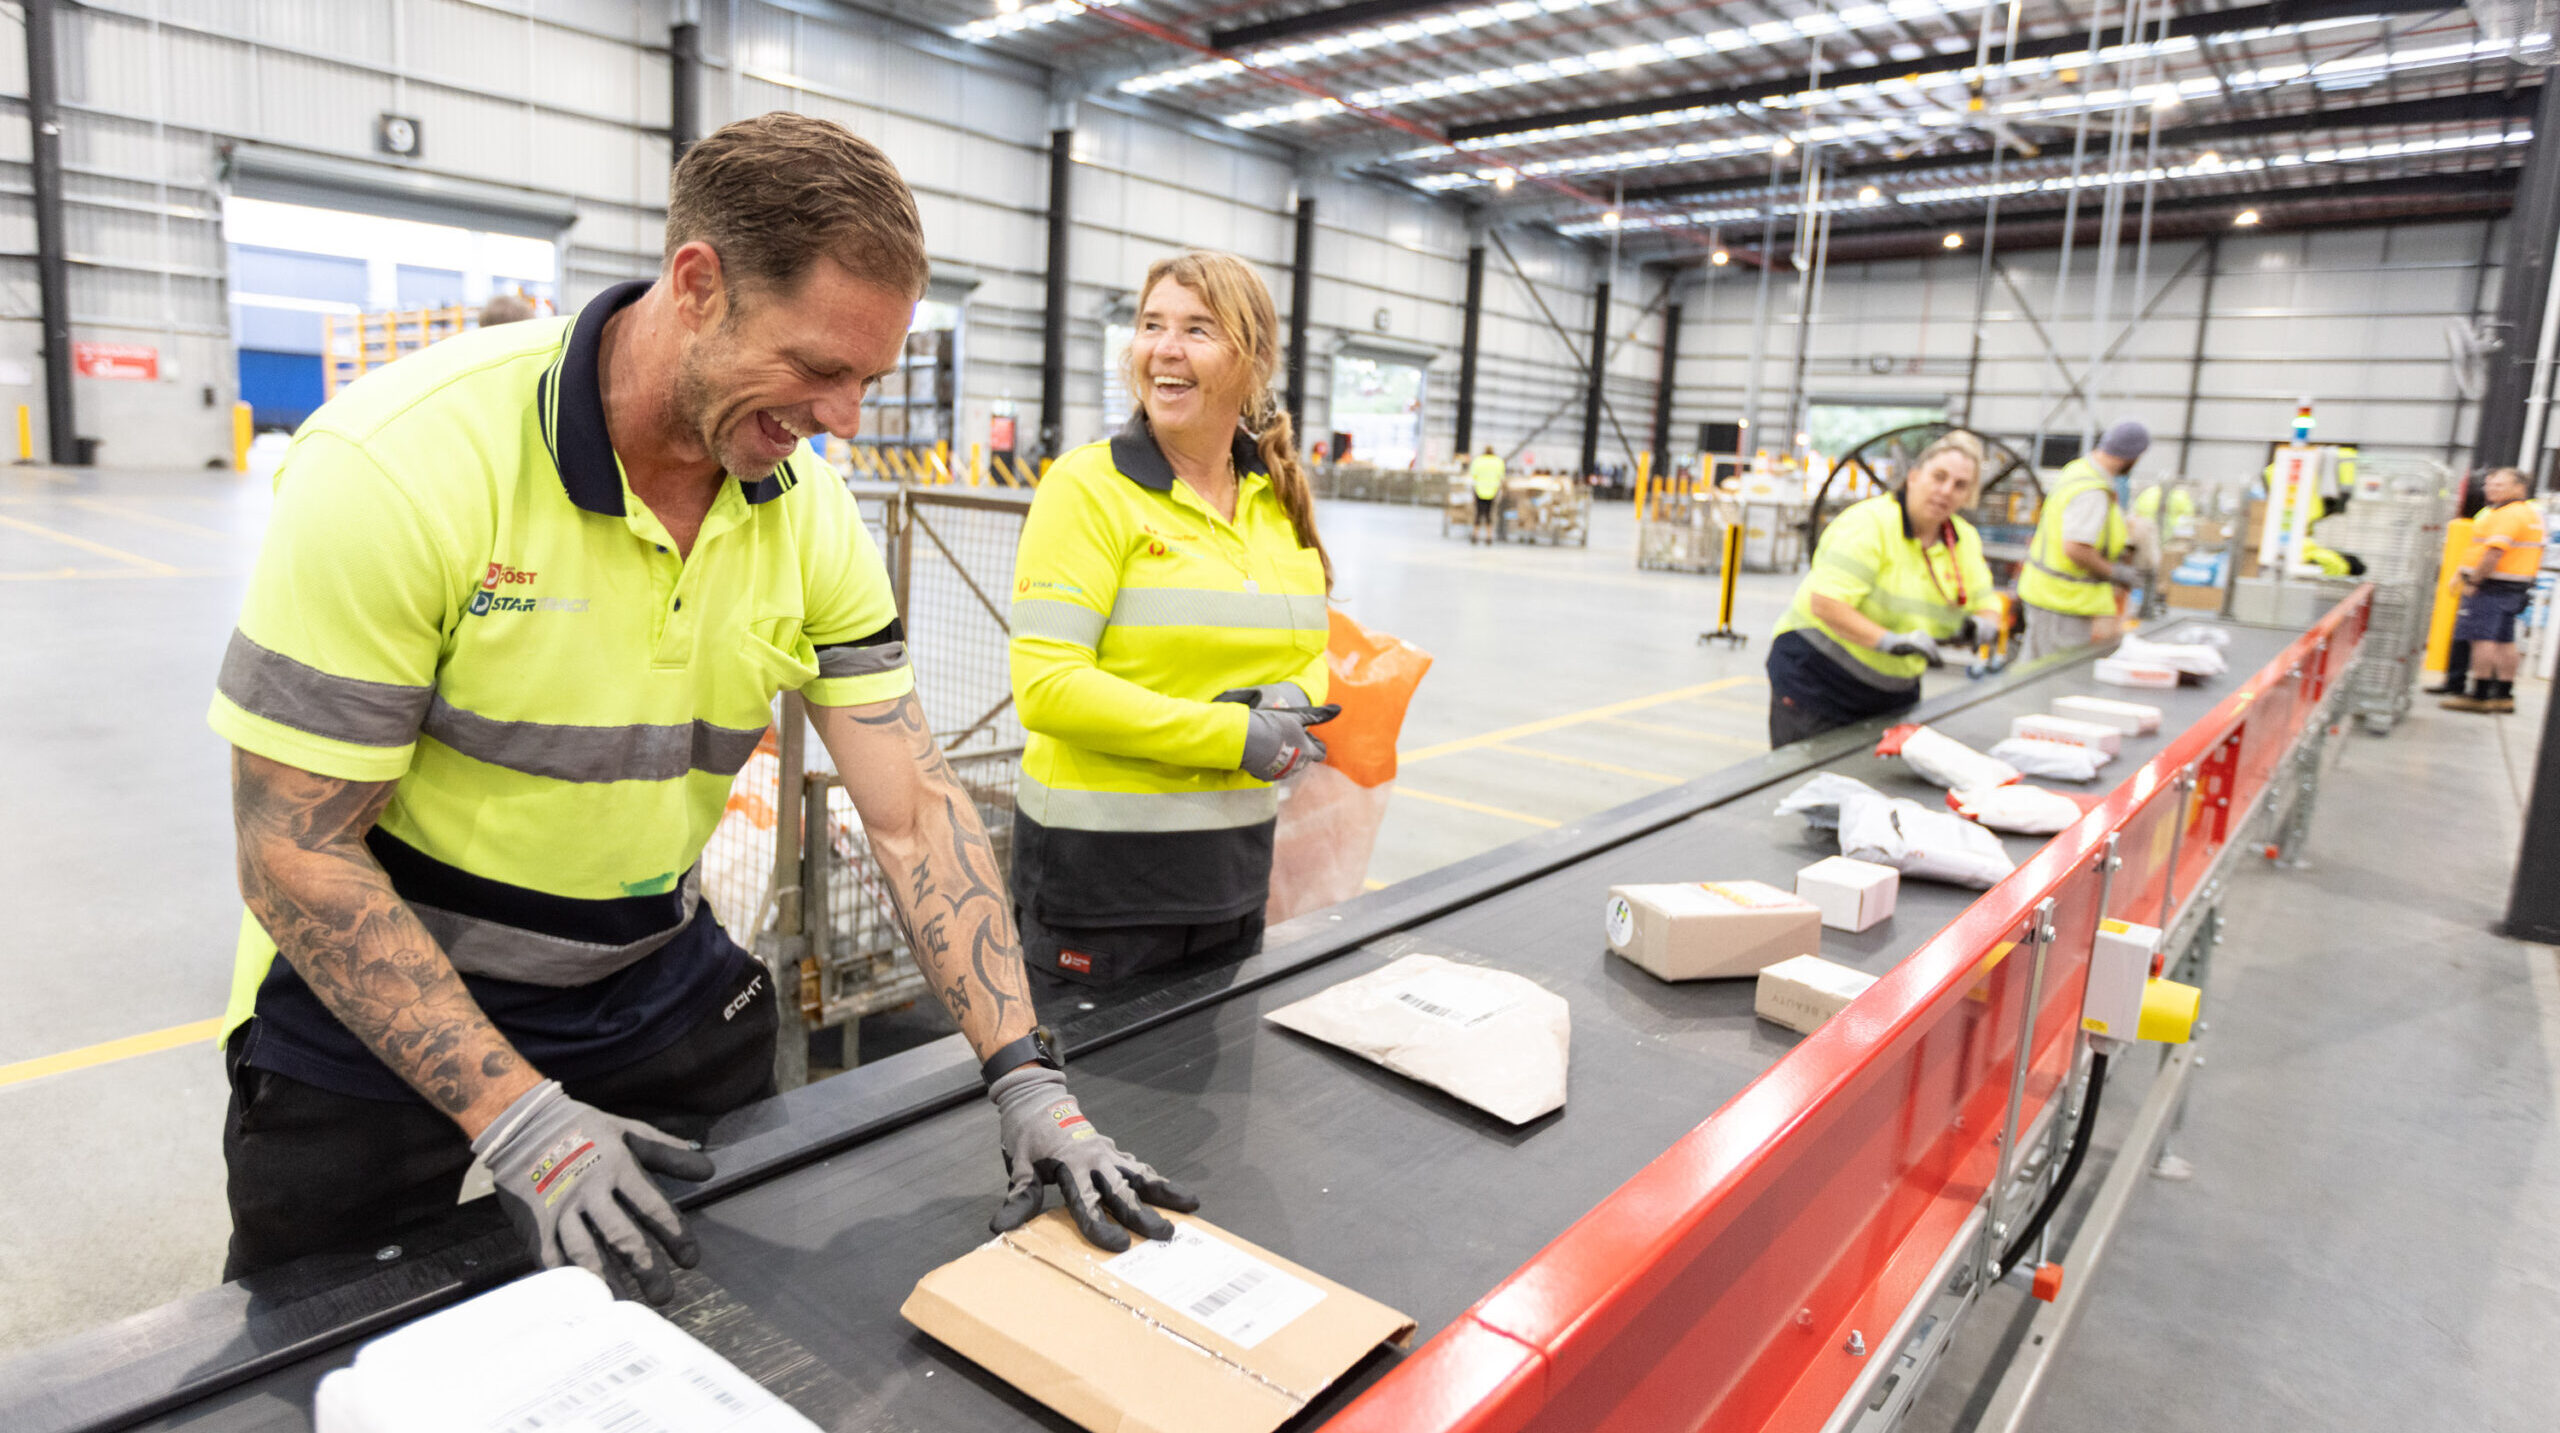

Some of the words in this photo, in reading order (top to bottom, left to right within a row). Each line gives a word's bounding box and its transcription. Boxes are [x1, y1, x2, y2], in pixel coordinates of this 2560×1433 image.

[387, 119, 415, 152] 9
[723, 975, 762, 1021] ECHT
[1771, 993, 1820, 1018] BEAUTY
